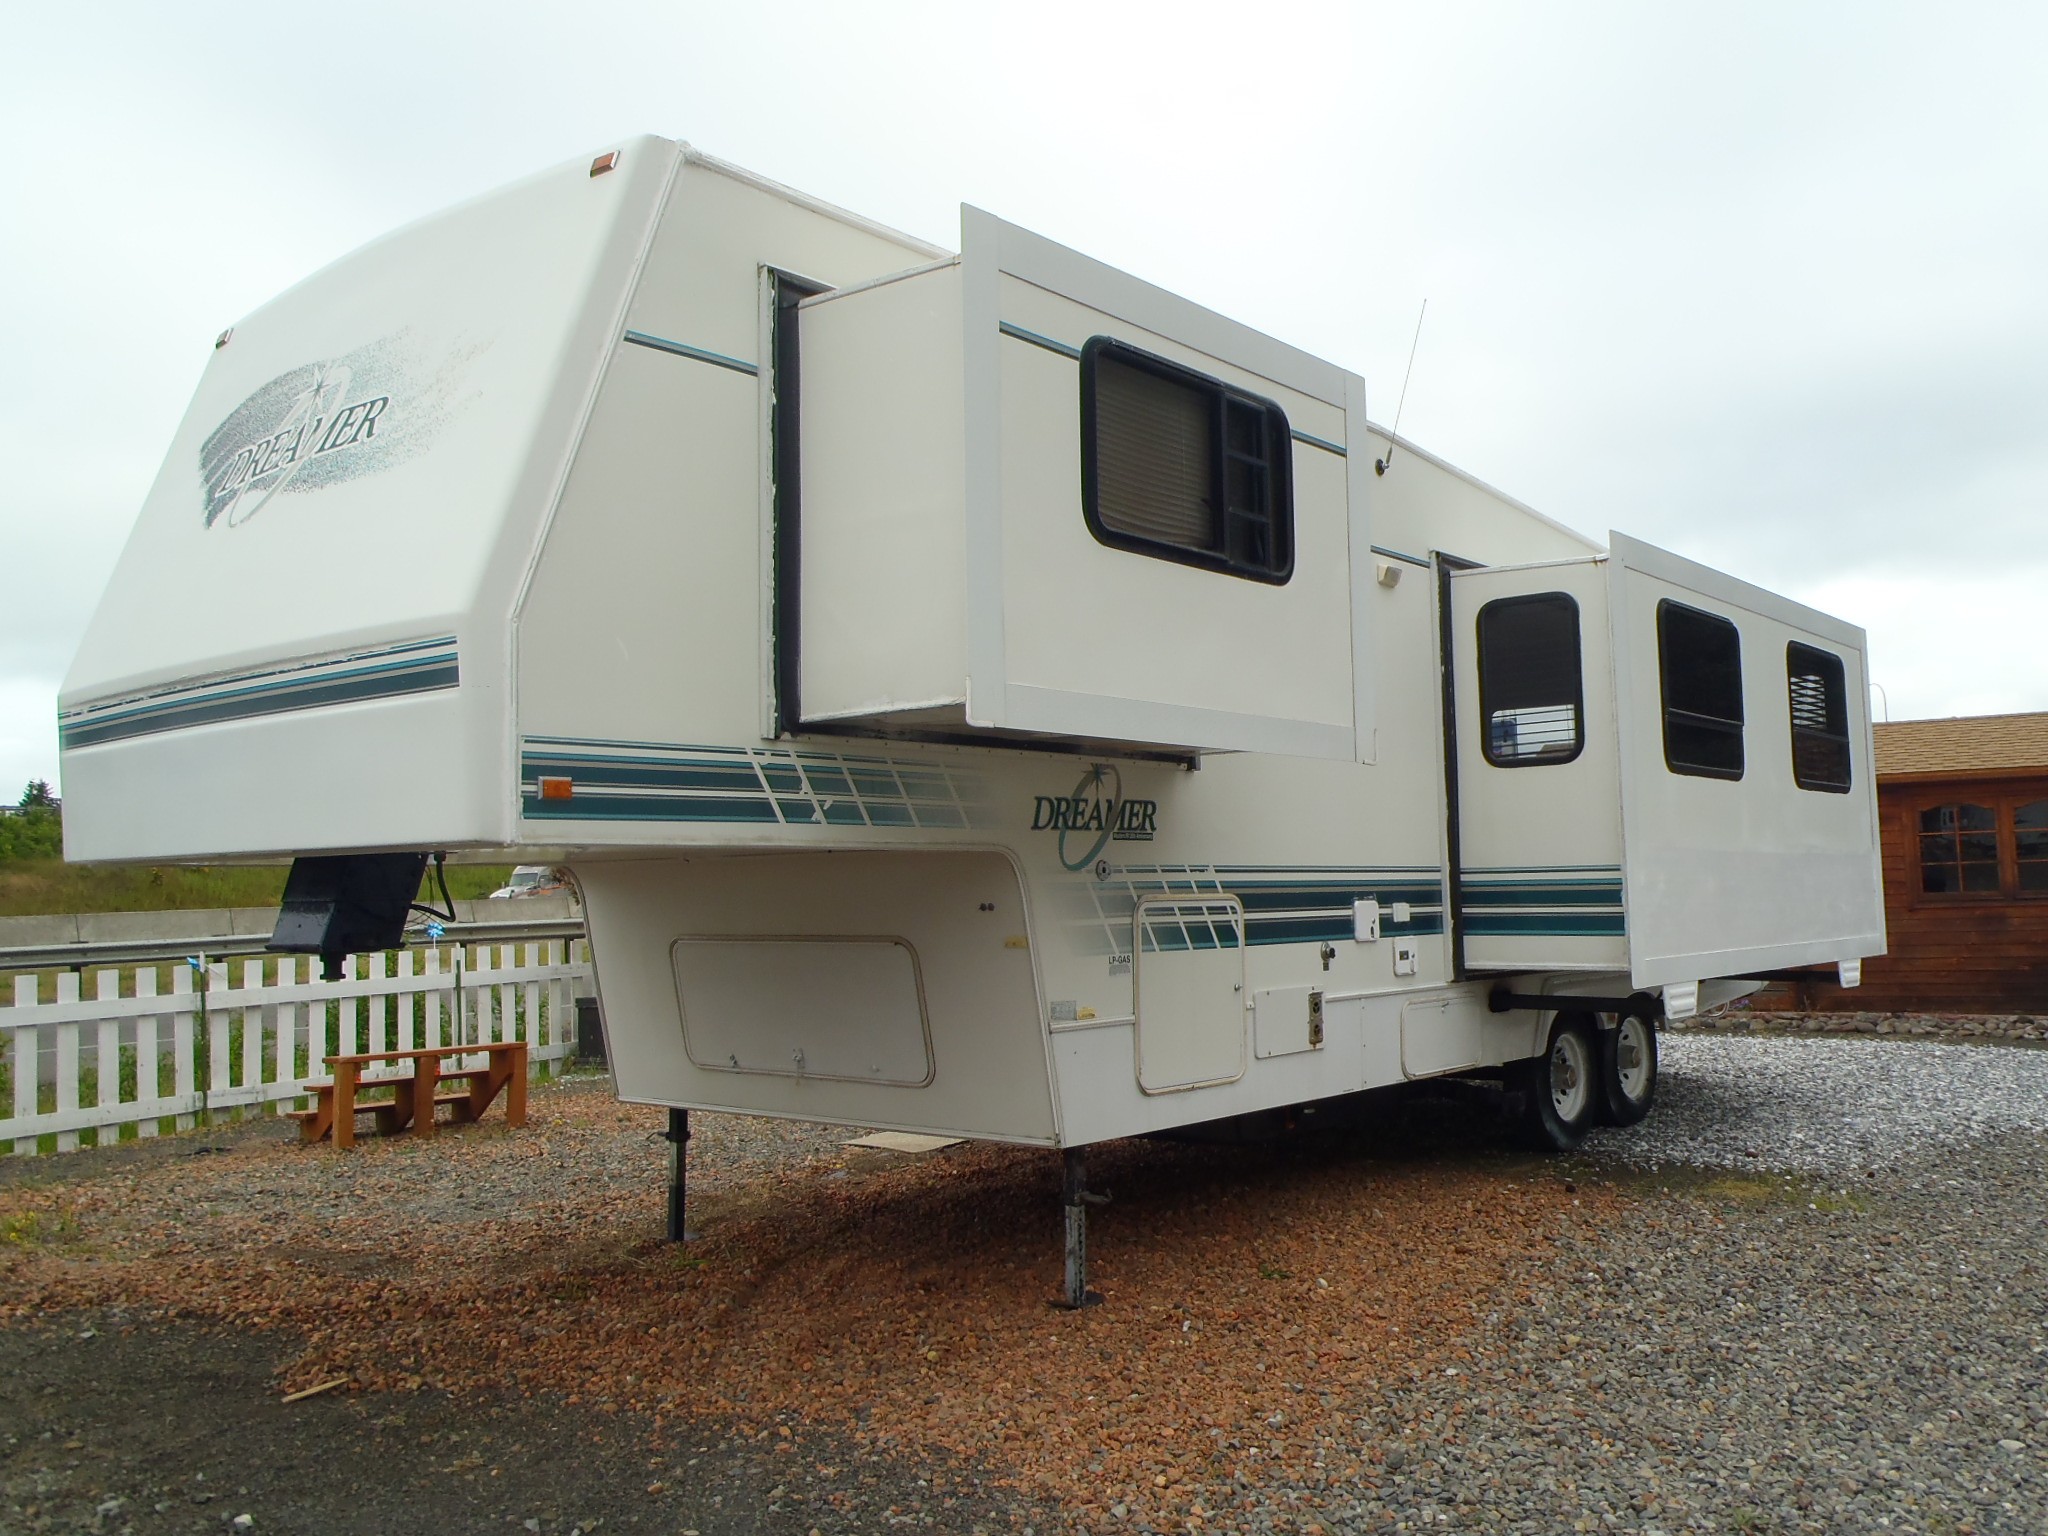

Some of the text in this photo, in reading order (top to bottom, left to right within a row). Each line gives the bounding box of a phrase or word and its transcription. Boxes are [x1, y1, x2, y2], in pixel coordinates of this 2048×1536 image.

[217, 396, 388, 494] DREAMER
[1031, 796, 1157, 831] DREAMER
[1108, 955, 1131, 964] LP-GAS
